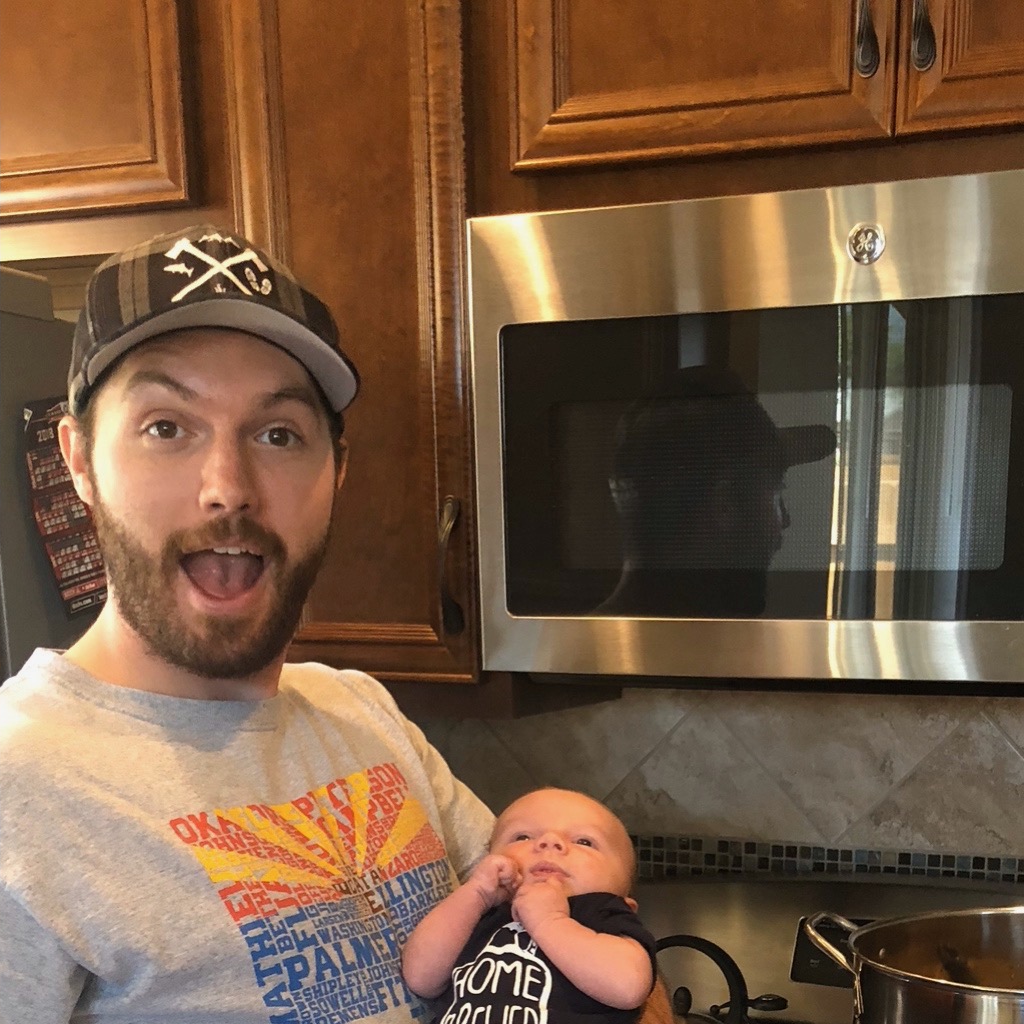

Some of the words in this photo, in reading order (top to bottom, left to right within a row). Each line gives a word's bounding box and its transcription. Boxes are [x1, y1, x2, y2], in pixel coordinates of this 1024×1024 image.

[364, 857, 451, 914] ELLINGTON
[317, 911, 391, 945] WASHINGTON
[282, 927, 400, 993] PALMER
[302, 970, 361, 1003] SHIPLEY
[455, 958, 542, 1001] HOME
[308, 985, 367, 1018] SOWELL
